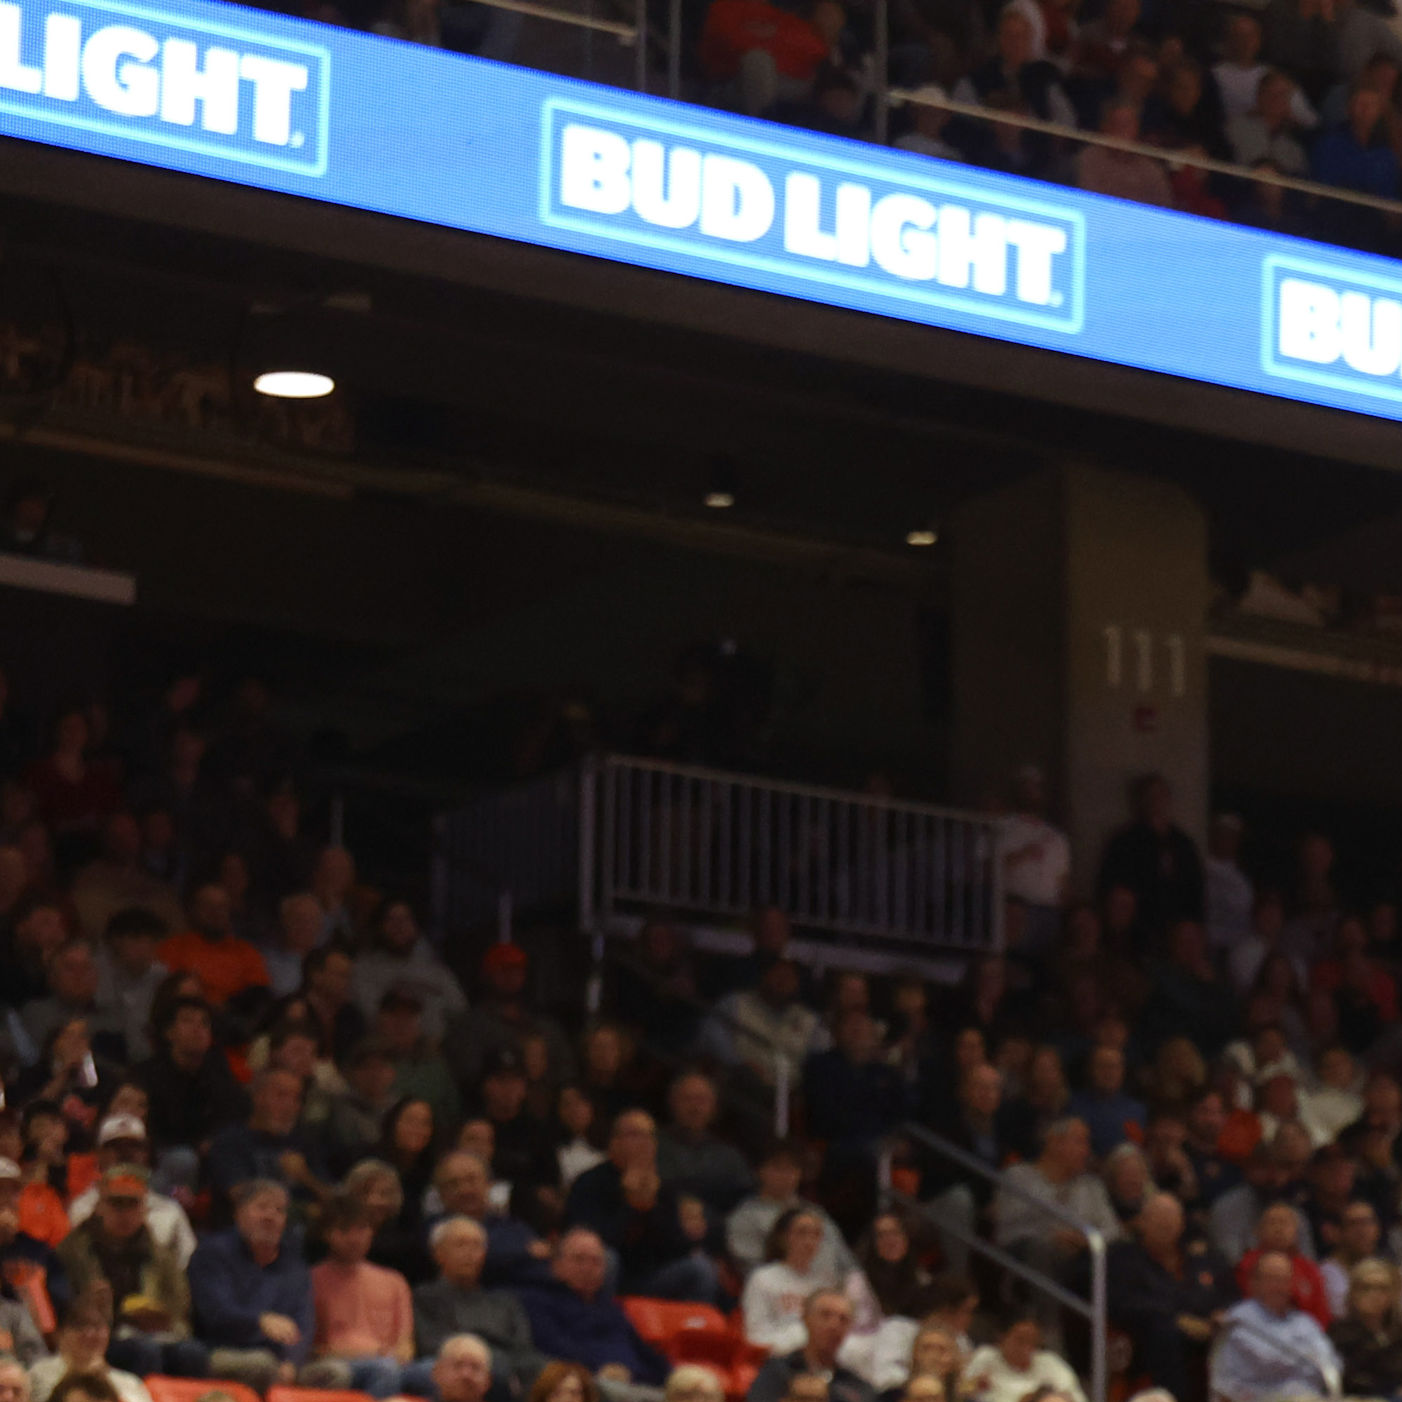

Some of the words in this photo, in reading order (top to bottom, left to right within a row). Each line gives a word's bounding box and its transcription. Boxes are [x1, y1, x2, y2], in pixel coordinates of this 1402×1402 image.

[0, 2, 308, 147] LIGHT
[561, 124, 775, 242] BUD
[784, 171, 1066, 306] LIGHT
